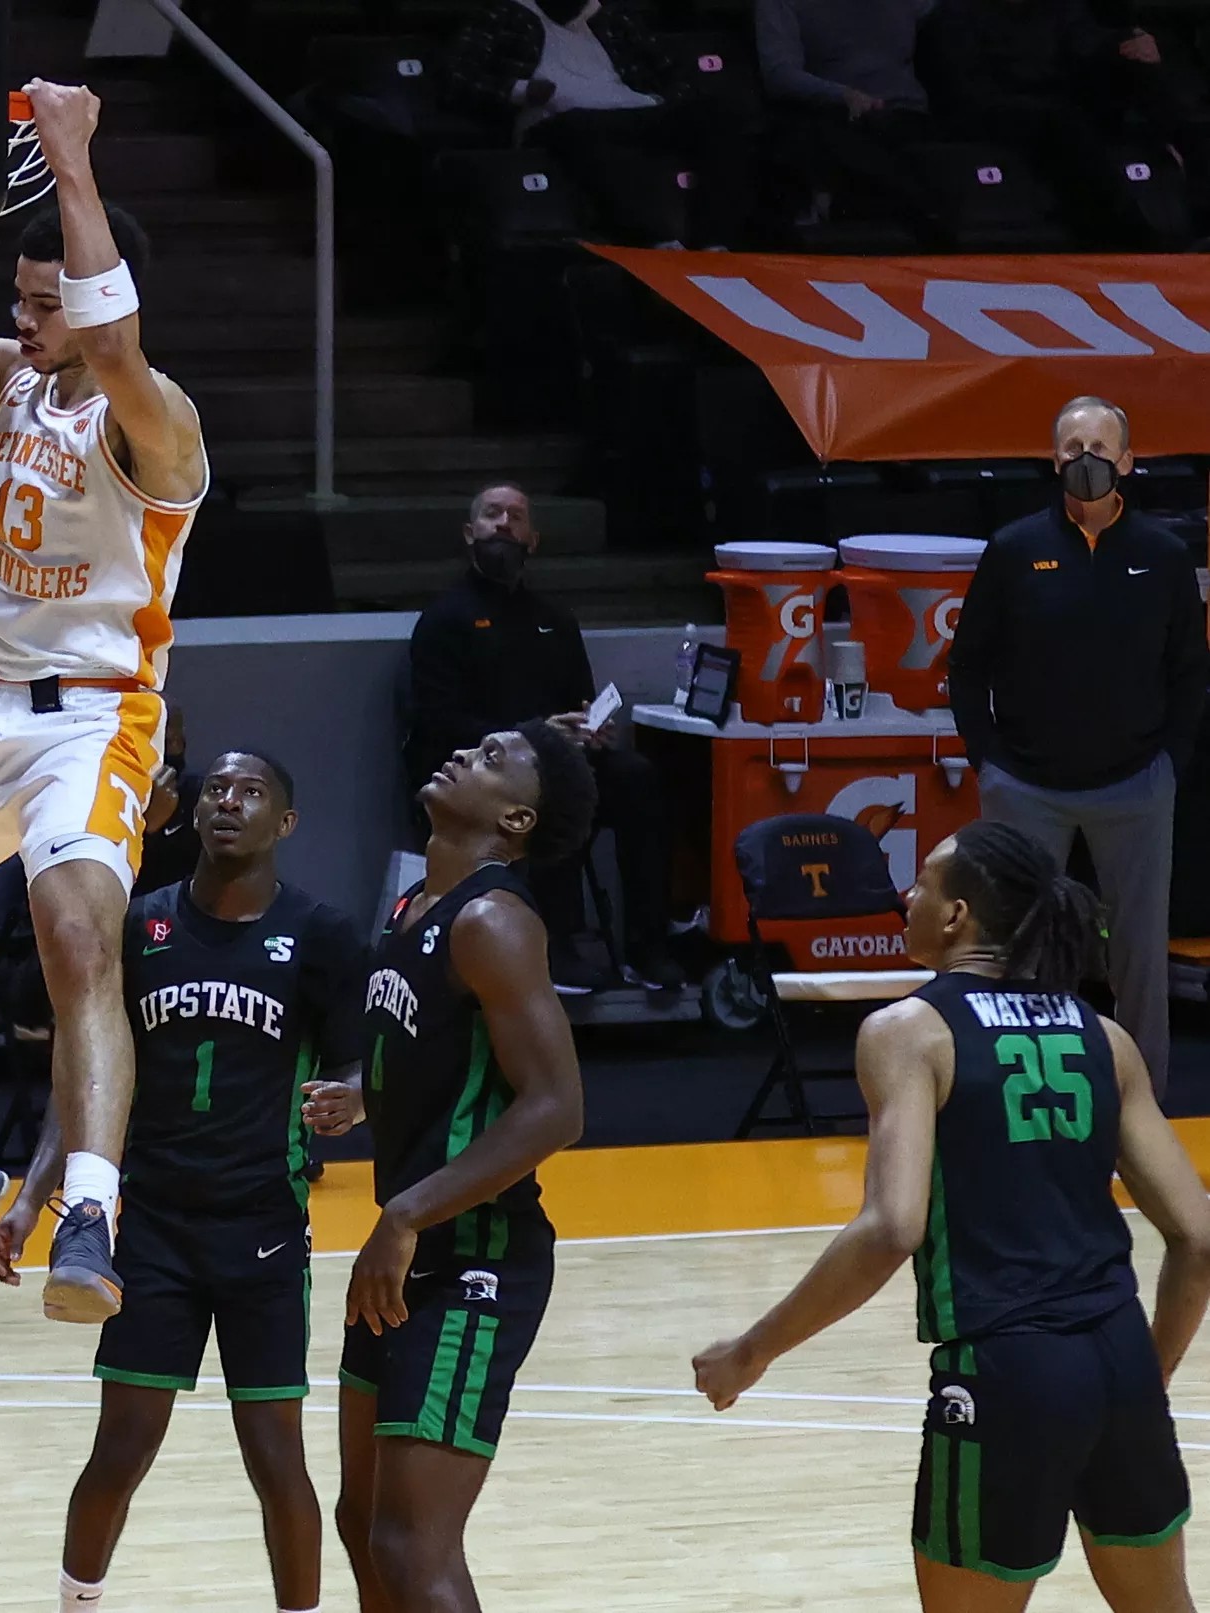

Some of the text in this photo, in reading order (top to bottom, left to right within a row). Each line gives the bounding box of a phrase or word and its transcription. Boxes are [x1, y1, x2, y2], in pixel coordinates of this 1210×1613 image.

[780, 595, 814, 638] G
[782, 832, 838, 847] BARNES
[801, 863, 829, 897] T
[140, 981, 284, 1040] UPSTATE
[192, 1040, 215, 1112] 1
[995, 1034, 1093, 1142] 25
